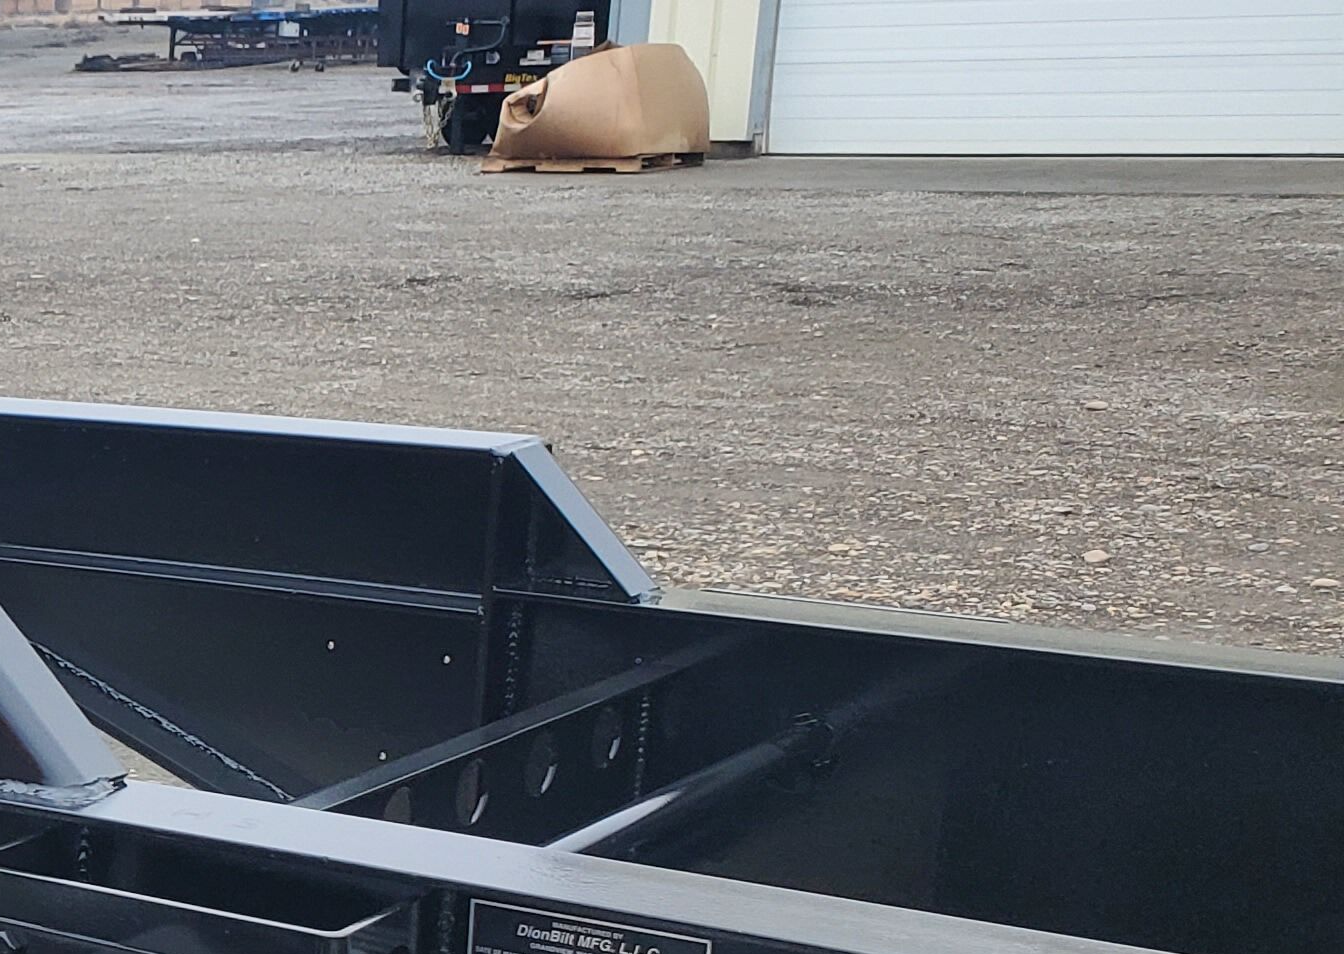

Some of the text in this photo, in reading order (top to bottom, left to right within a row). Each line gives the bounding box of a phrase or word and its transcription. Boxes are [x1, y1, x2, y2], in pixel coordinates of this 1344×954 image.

[517, 923, 575, 946] DionBilt
[576, 934, 616, 953] MFG.
[612, 932, 623, 940] BY
